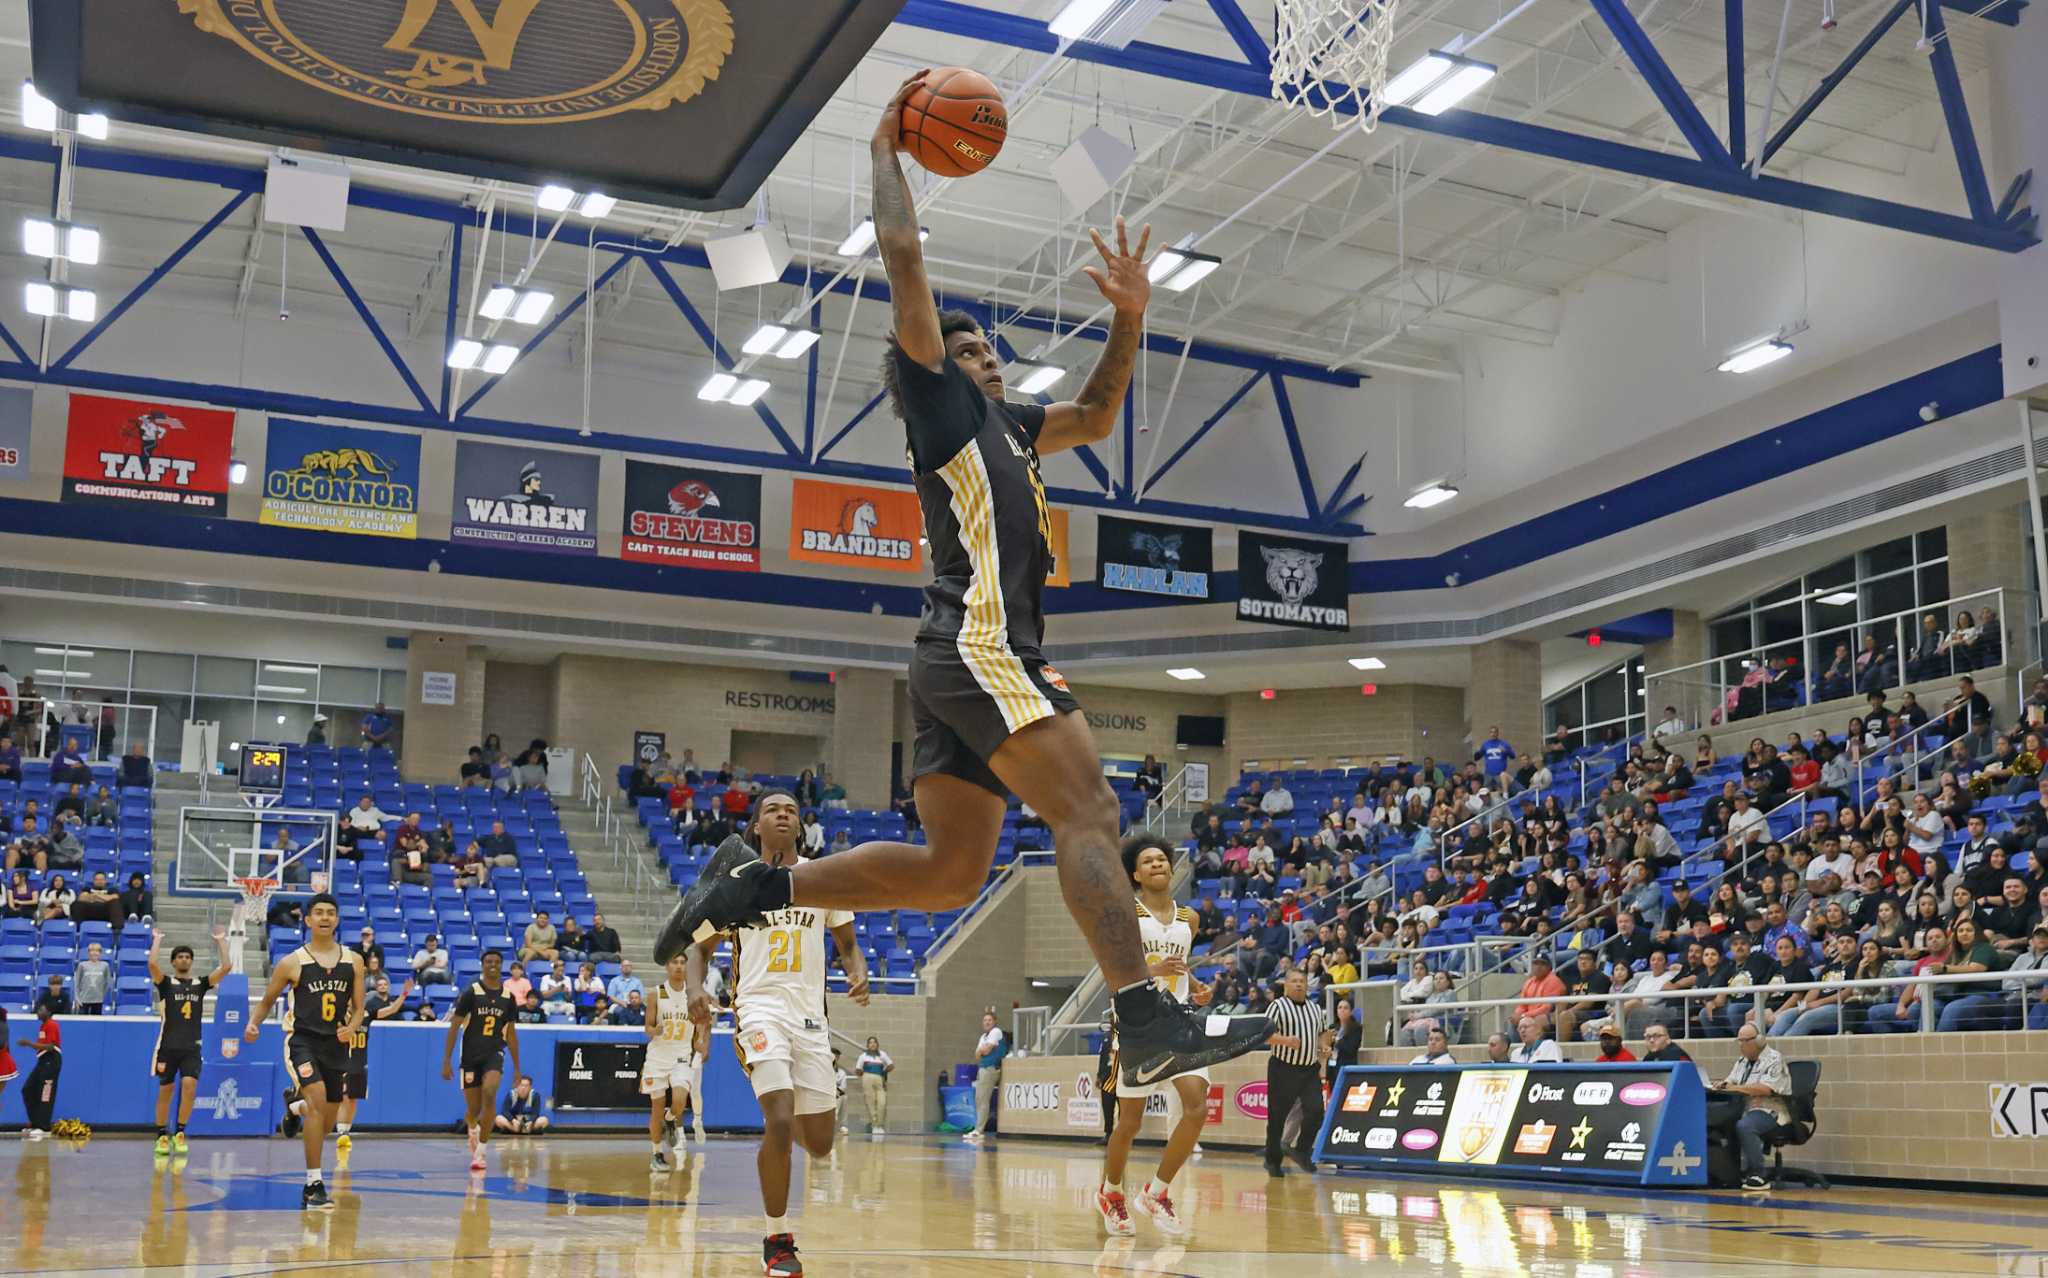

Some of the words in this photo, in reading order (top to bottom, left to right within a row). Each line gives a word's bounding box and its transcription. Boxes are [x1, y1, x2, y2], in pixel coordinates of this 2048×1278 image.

[245, 25, 358, 86] SCHOOL
[608, 16, 681, 101] NORTHSIDE
[364, 84, 603, 116] INDEPENDENT
[100, 452, 195, 485] TAFT
[75, 483, 180, 502] COMMUNICATIONS
[184, 495, 215, 506] ARTS
[268, 471, 412, 511] O'CONNOR
[466, 498, 586, 531] WARREN
[631, 511, 754, 546] STEVENS
[802, 529, 912, 560] BRANDEIS
[1239, 598, 1347, 625] SOTOMAYOR
[725, 690, 835, 714] RESTROOMS
[252, 752, 280, 767] 2:29
[766, 930, 803, 973] 21
[180, 1000, 193, 1020] 4
[321, 992, 337, 1022] 6
[482, 1015, 496, 1036] 2
[662, 1020, 687, 1041] 33
[569, 1070, 593, 1080] HOME
[615, 1070, 638, 1079] PERIOD
[1005, 1082, 1060, 1109] KRYSUS
